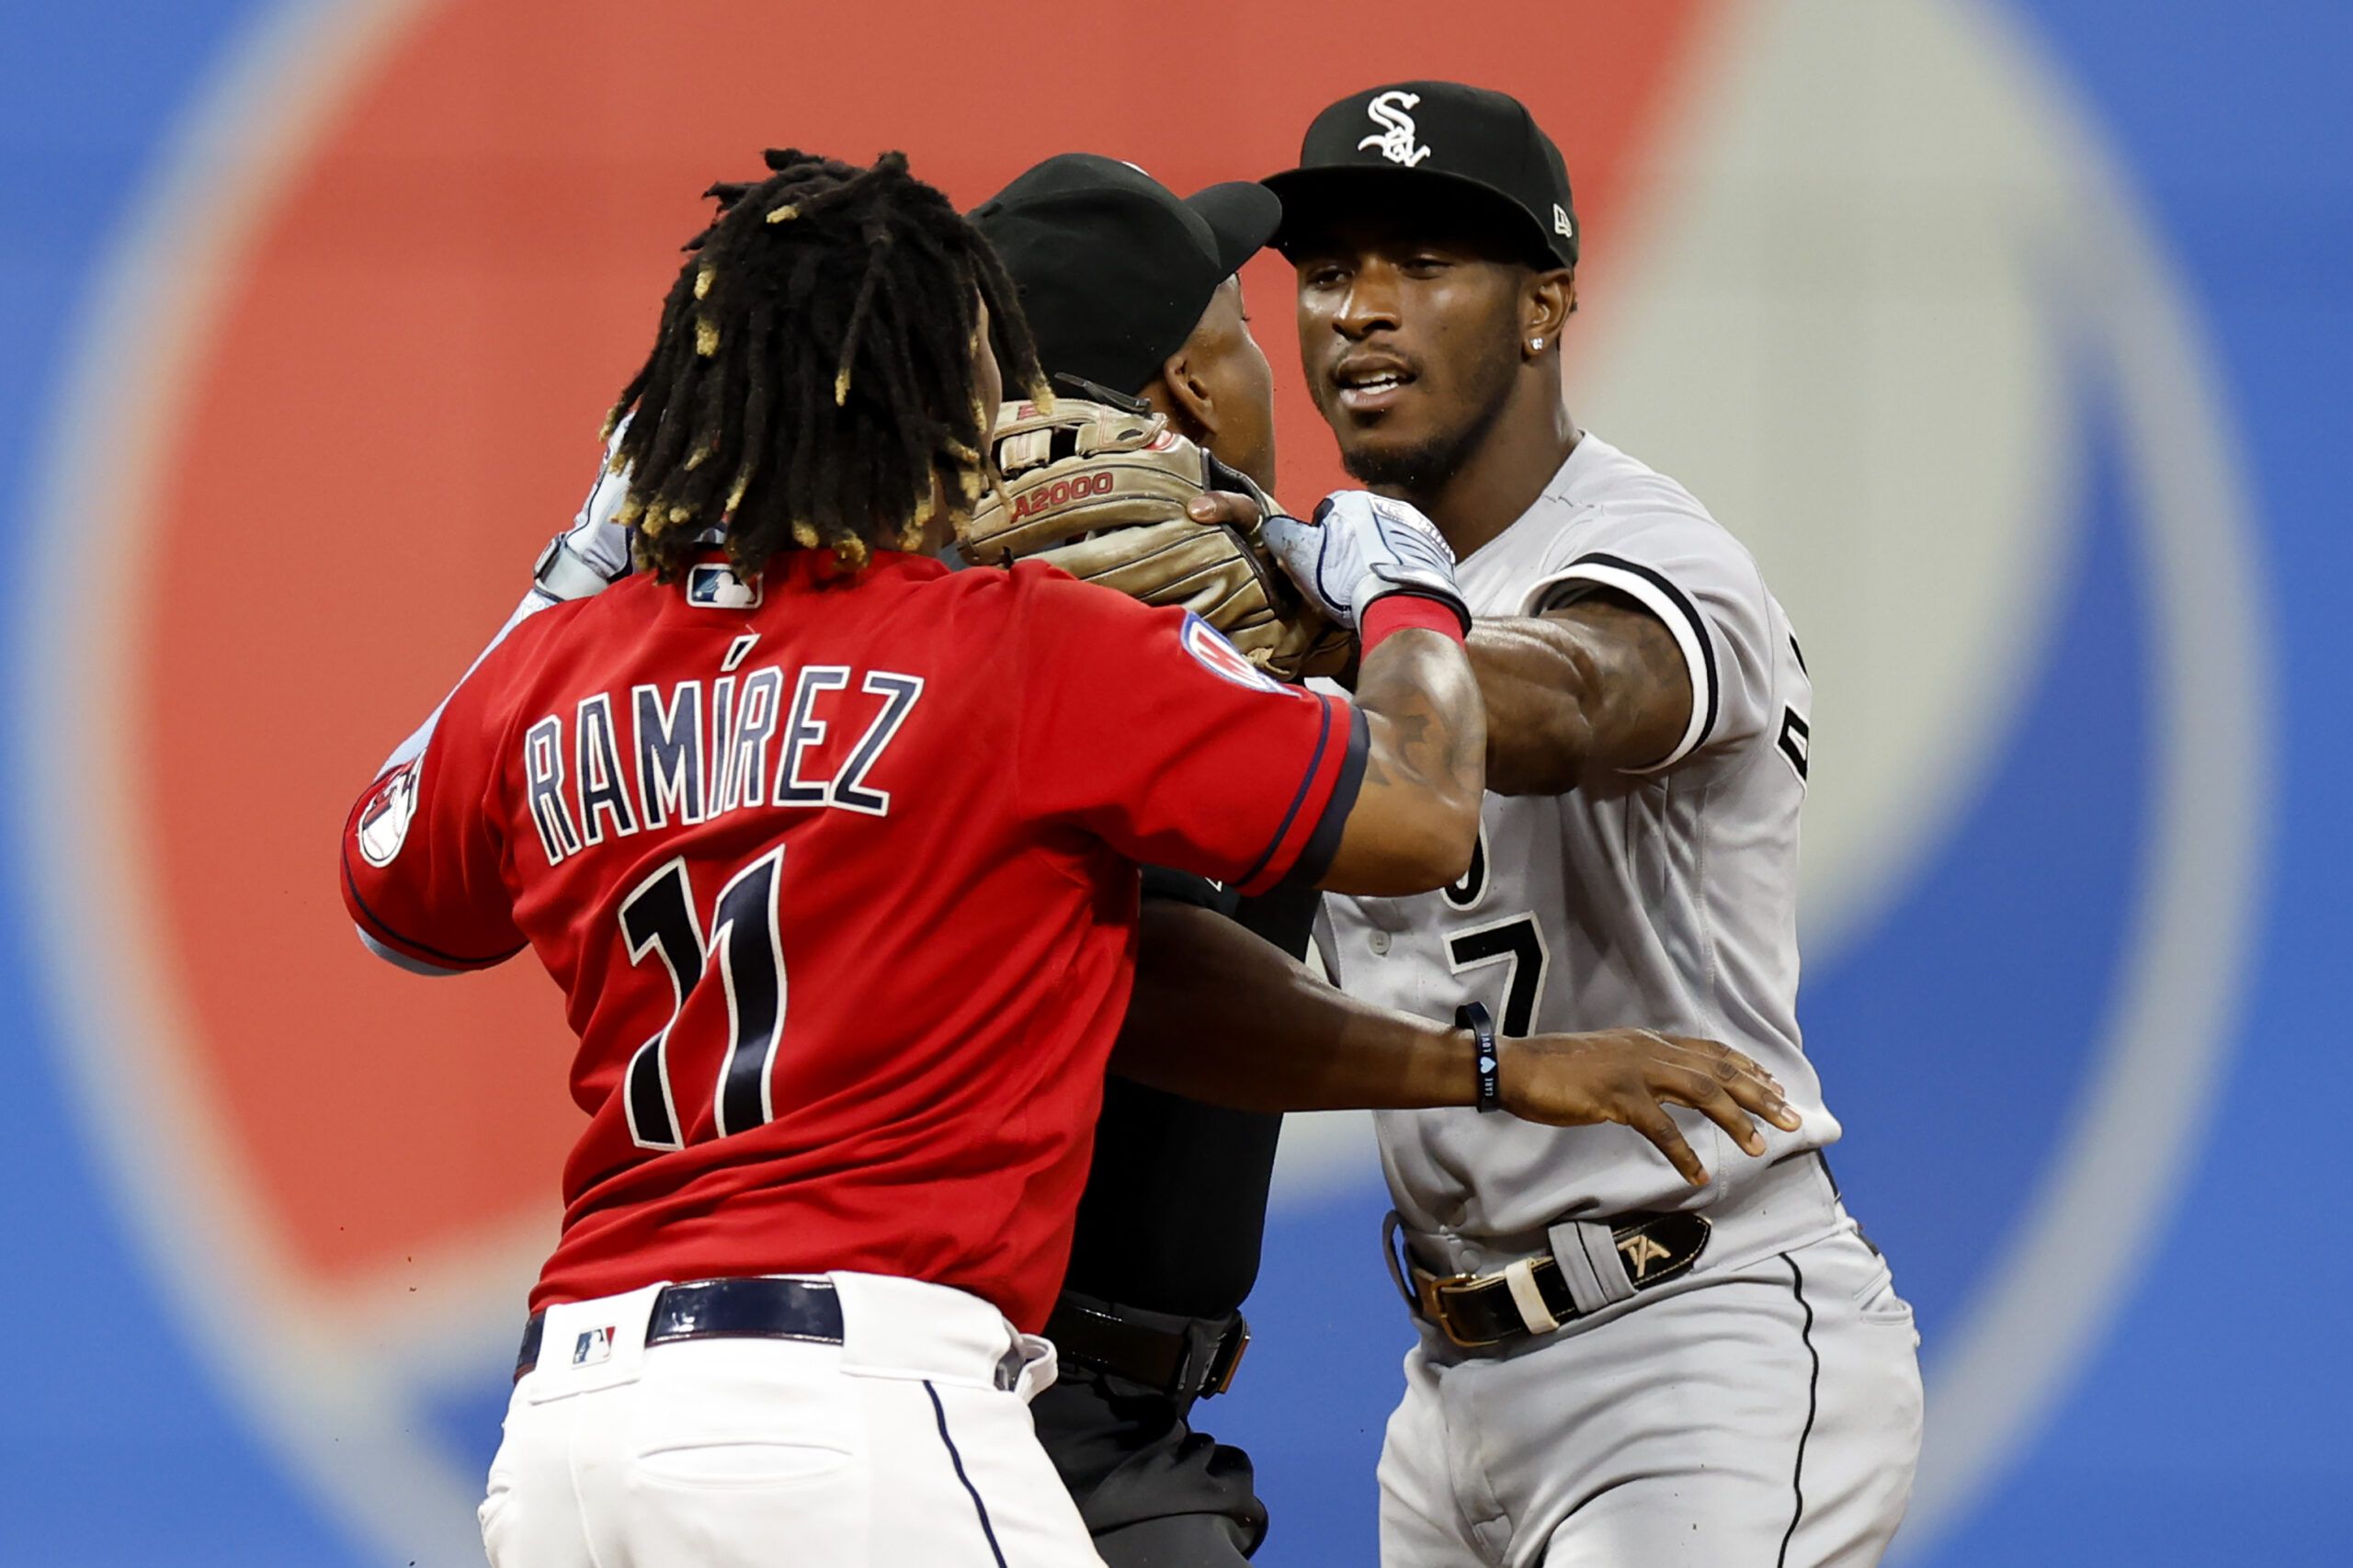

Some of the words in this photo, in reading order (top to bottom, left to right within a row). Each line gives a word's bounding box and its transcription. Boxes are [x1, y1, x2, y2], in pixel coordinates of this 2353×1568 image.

[1010, 472, 1114, 523] A2000
[525, 633, 924, 866] RAMÍREZ
[619, 842, 788, 1151] 11
[1441, 911, 1550, 1038] 7
[1480, 1032, 1492, 1053] LOVE
